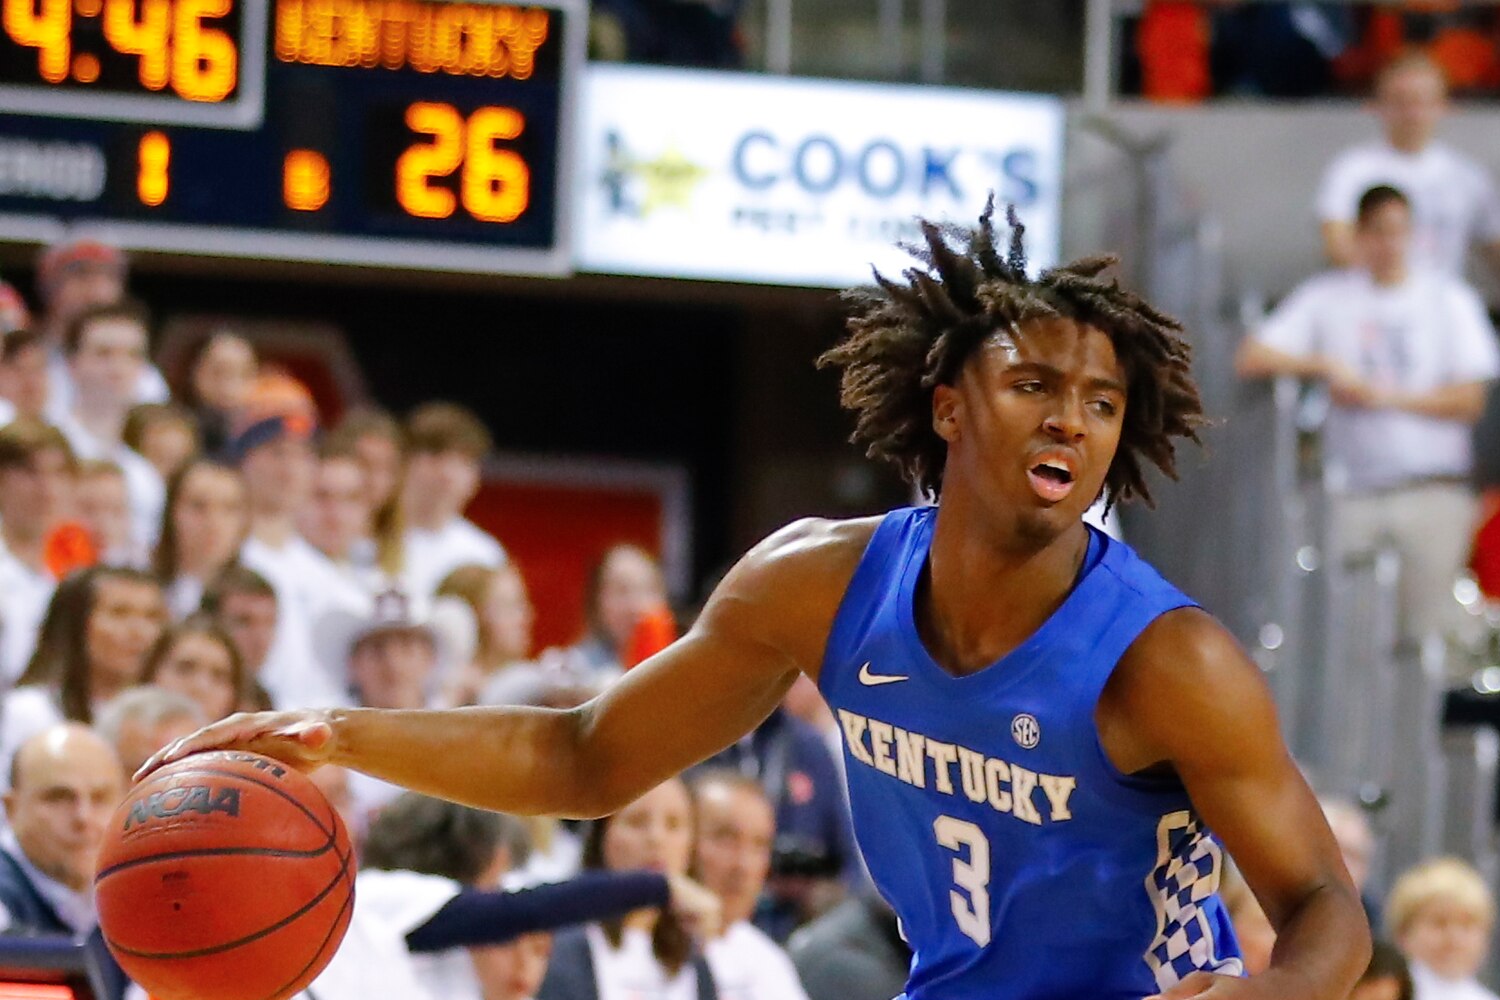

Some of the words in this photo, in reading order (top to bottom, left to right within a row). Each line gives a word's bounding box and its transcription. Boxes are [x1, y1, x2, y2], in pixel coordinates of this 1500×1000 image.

[3, 0, 238, 102] 4:46
[137, 131, 170, 206] 1
[396, 101, 530, 223] 26
[838, 708, 1076, 825] KENTUCKY
[1012, 714, 1040, 749] SEC
[124, 785, 242, 831] NCAA
[933, 814, 992, 948] 3
